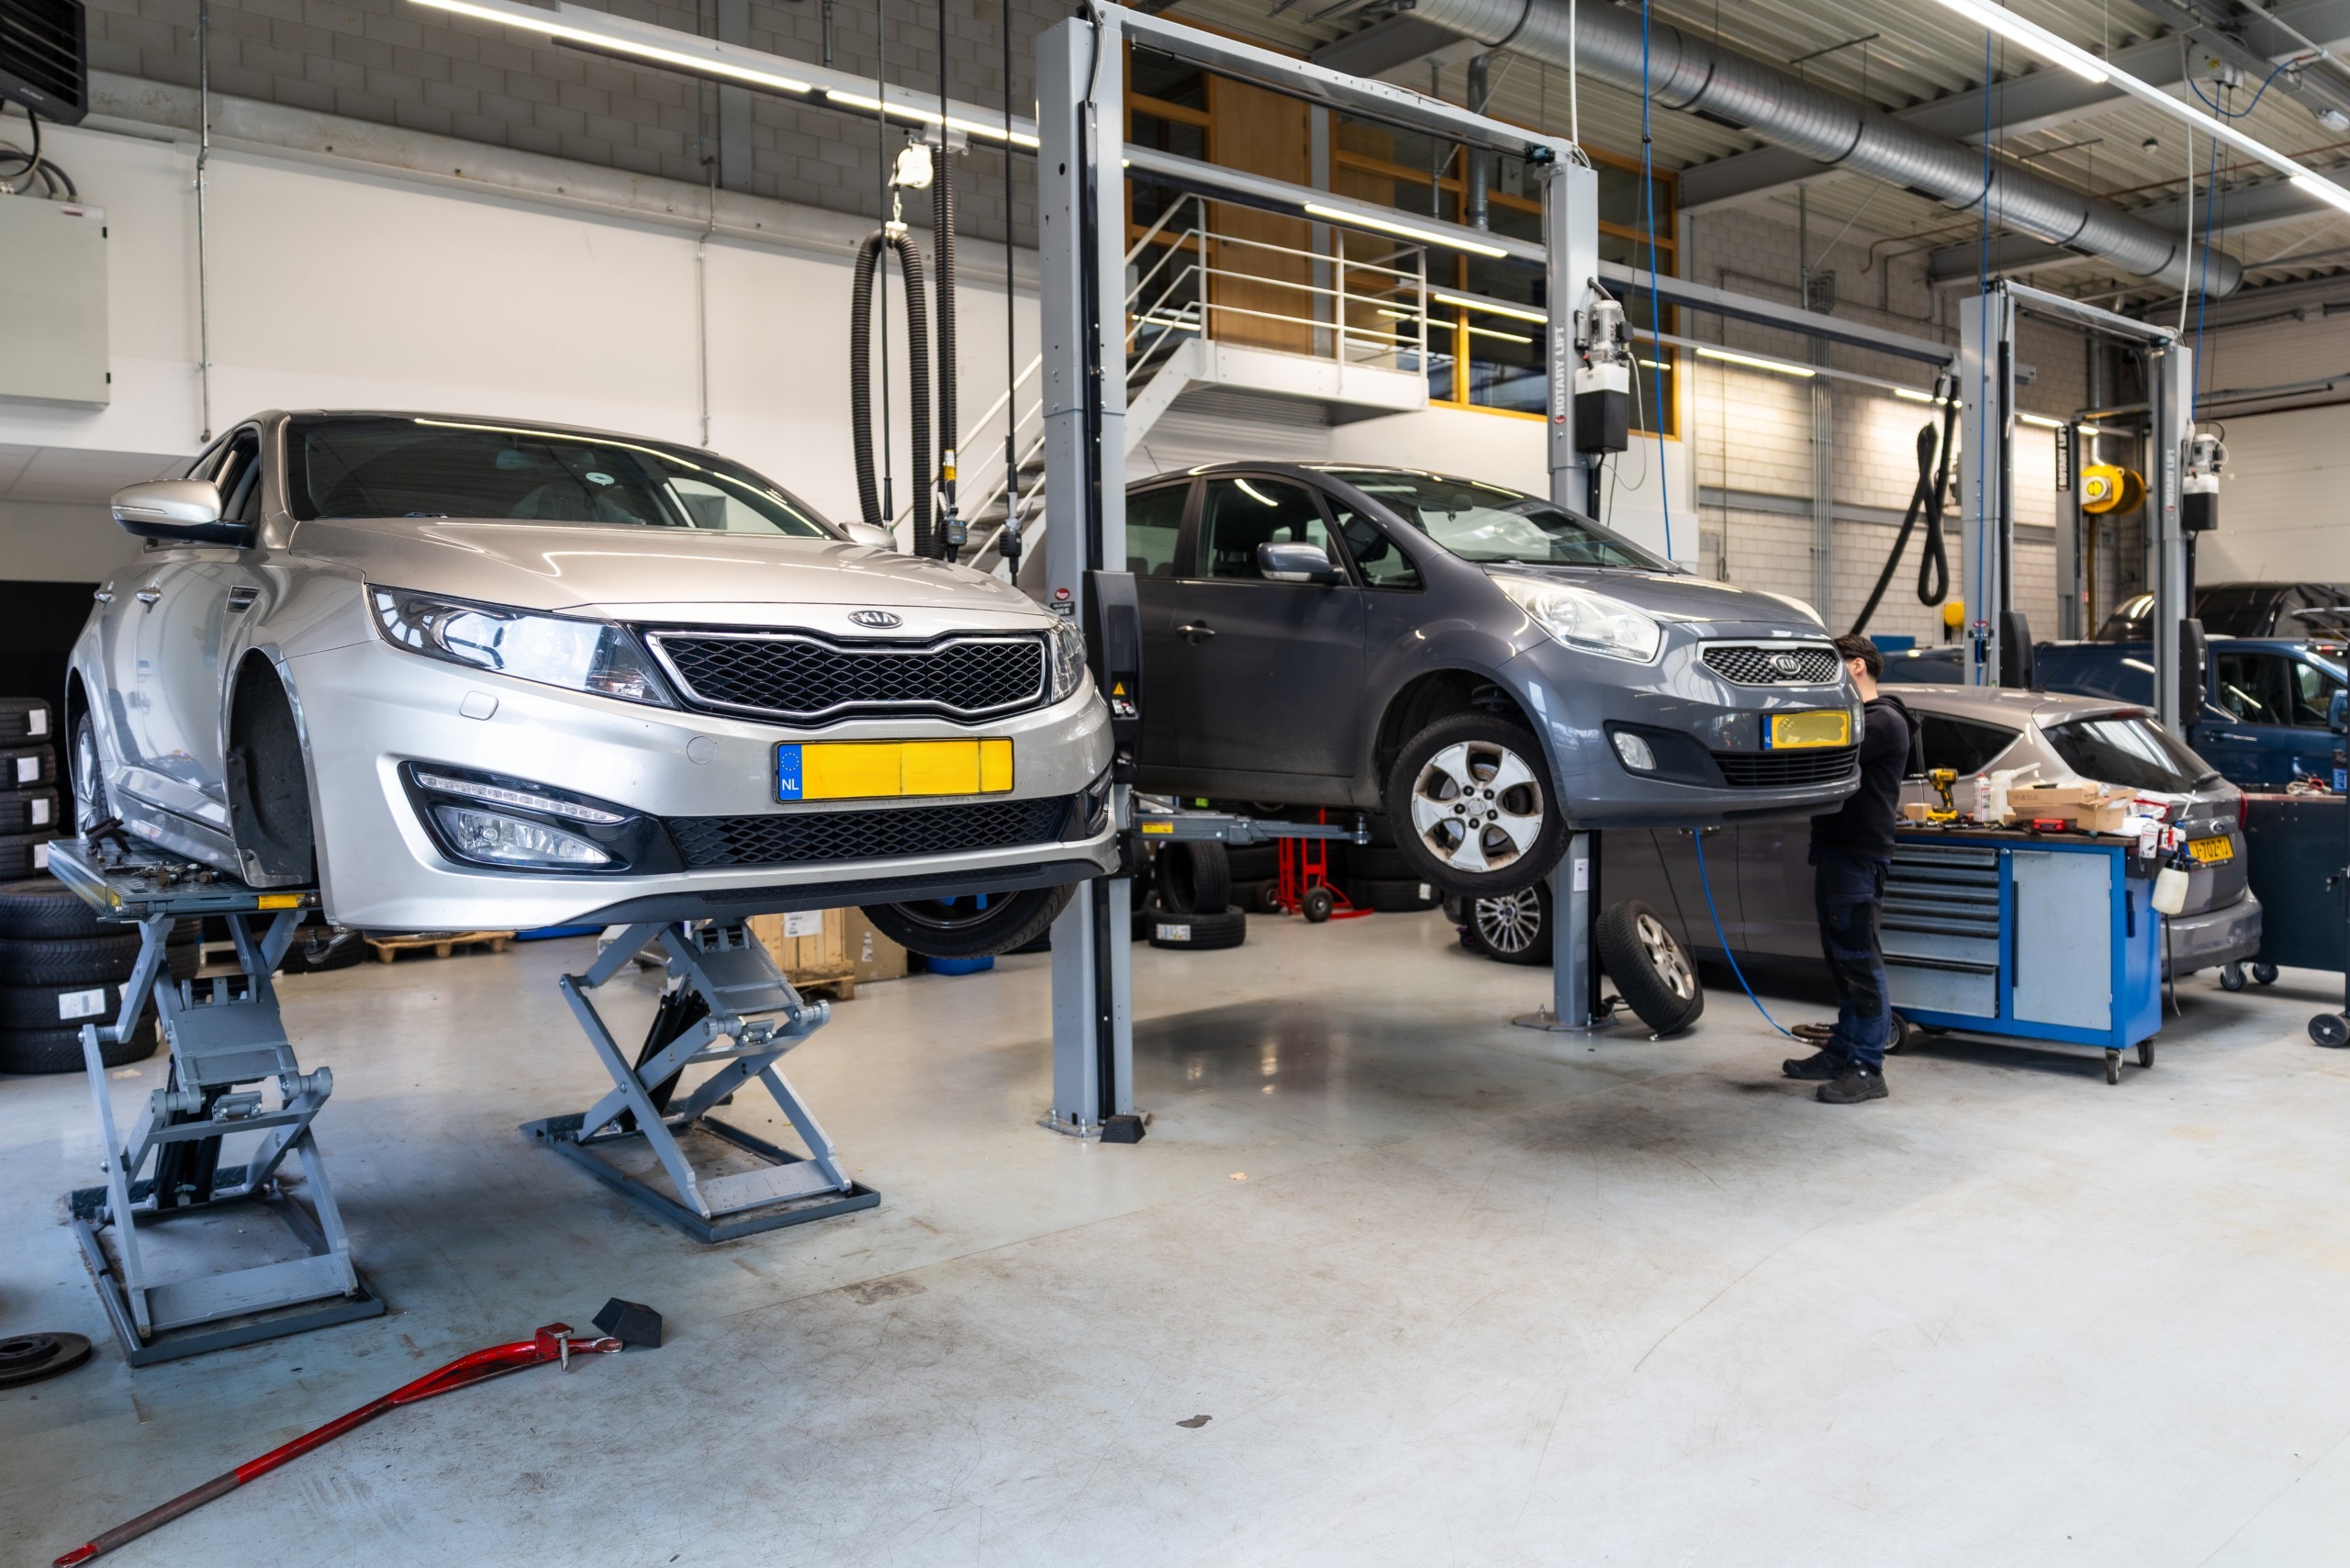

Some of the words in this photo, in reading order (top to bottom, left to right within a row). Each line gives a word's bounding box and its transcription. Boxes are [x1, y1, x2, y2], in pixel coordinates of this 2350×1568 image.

[1555, 327, 1565, 355] LIFT
[1555, 361, 1565, 416] ROTARY
[2166, 449, 2176, 469] LIFT
[2166, 469, 2176, 506] ROTARY
[859, 611, 897, 624] KIA
[1778, 658, 1798, 670] KIA
[782, 778, 800, 790] NL
